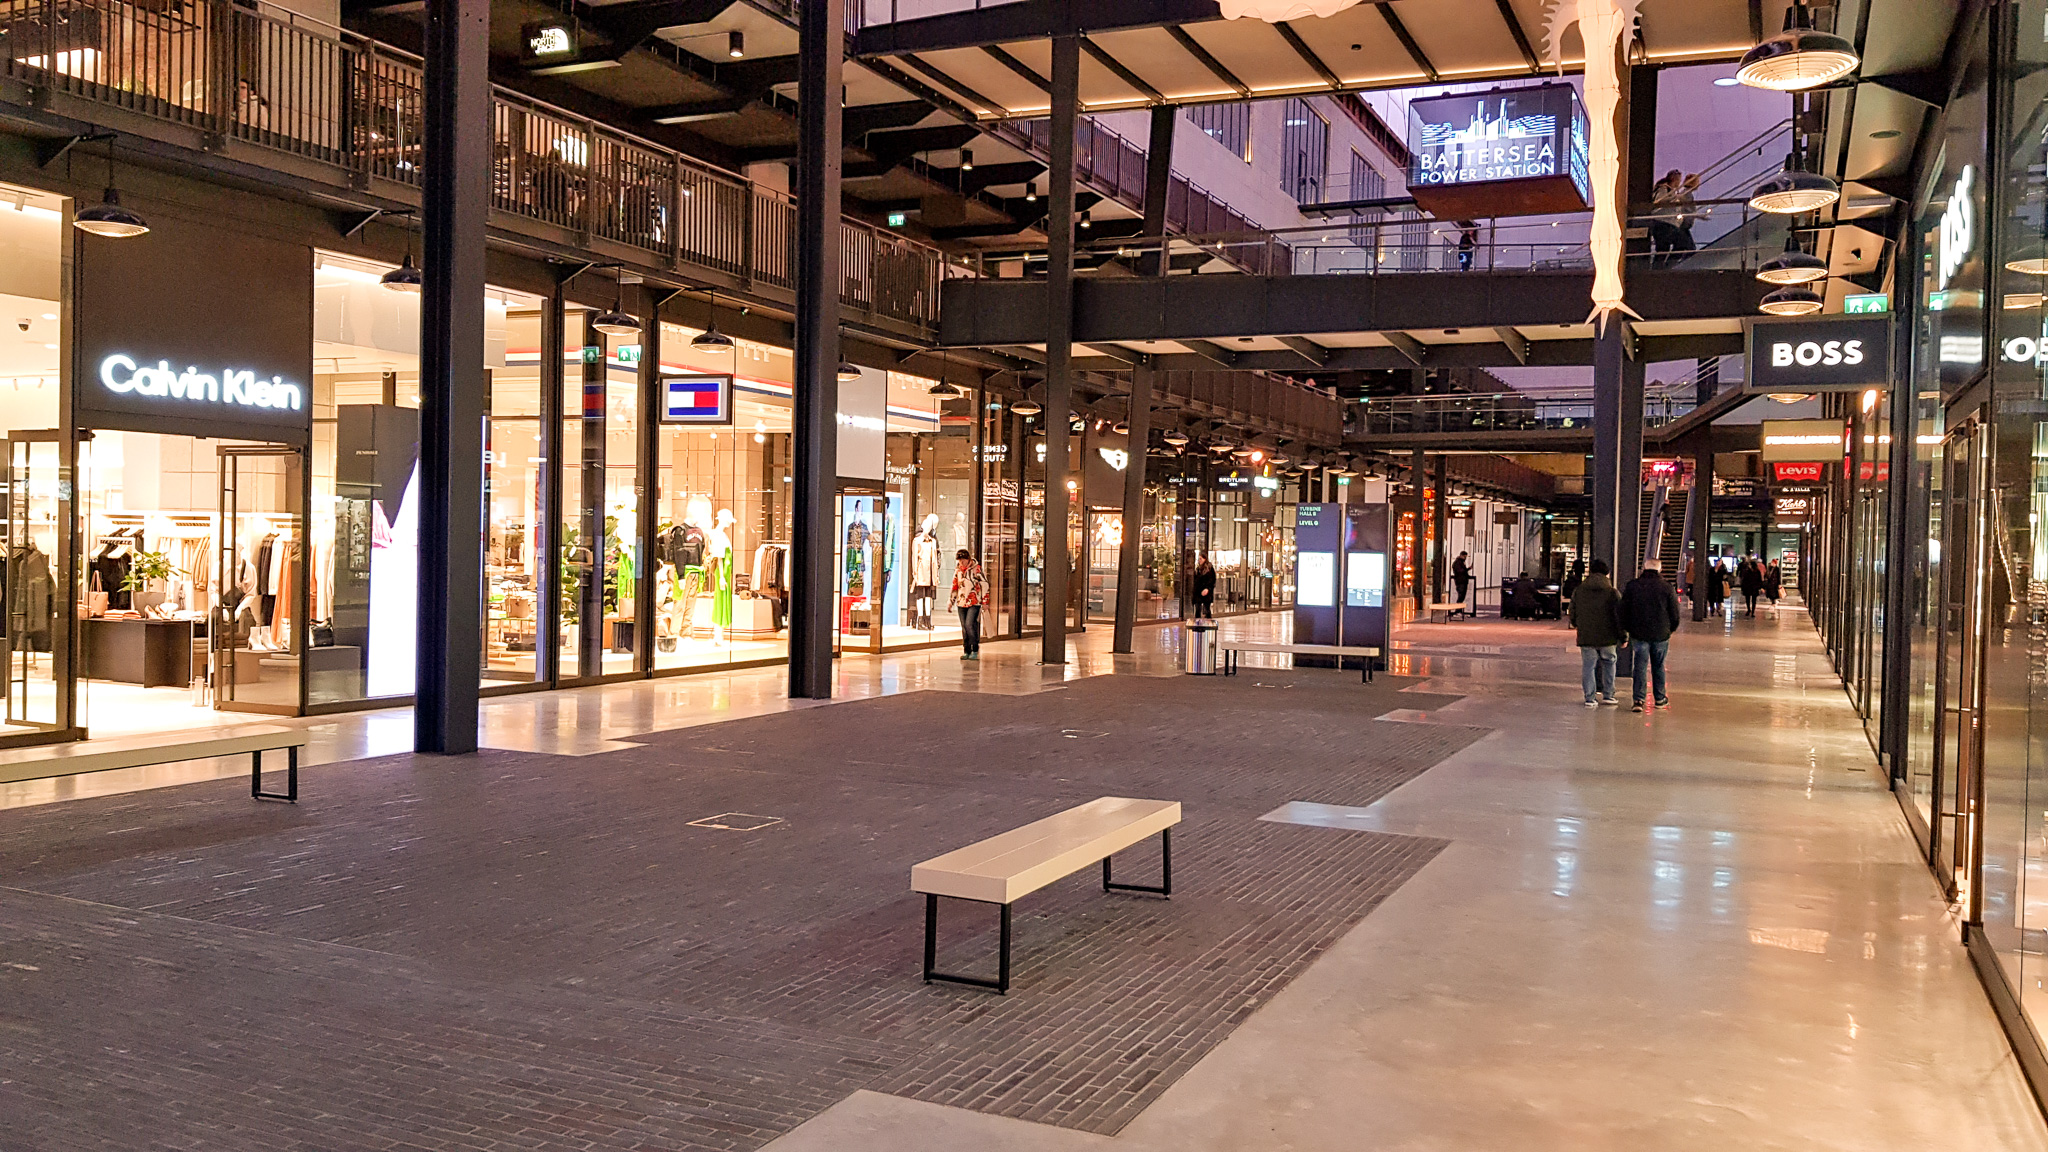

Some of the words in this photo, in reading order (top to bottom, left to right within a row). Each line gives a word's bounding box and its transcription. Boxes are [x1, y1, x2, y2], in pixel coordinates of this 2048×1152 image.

[531, 36, 555, 48] NORTH
[541, 29, 555, 38] THE
[1421, 142, 1554, 170] BATTERSEA
[1420, 168, 1478, 184] POWER
[1485, 161, 1555, 178] STATION
[1772, 339, 1864, 367] BOSS
[101, 354, 219, 402] Calvin
[223, 368, 301, 411] Klein
